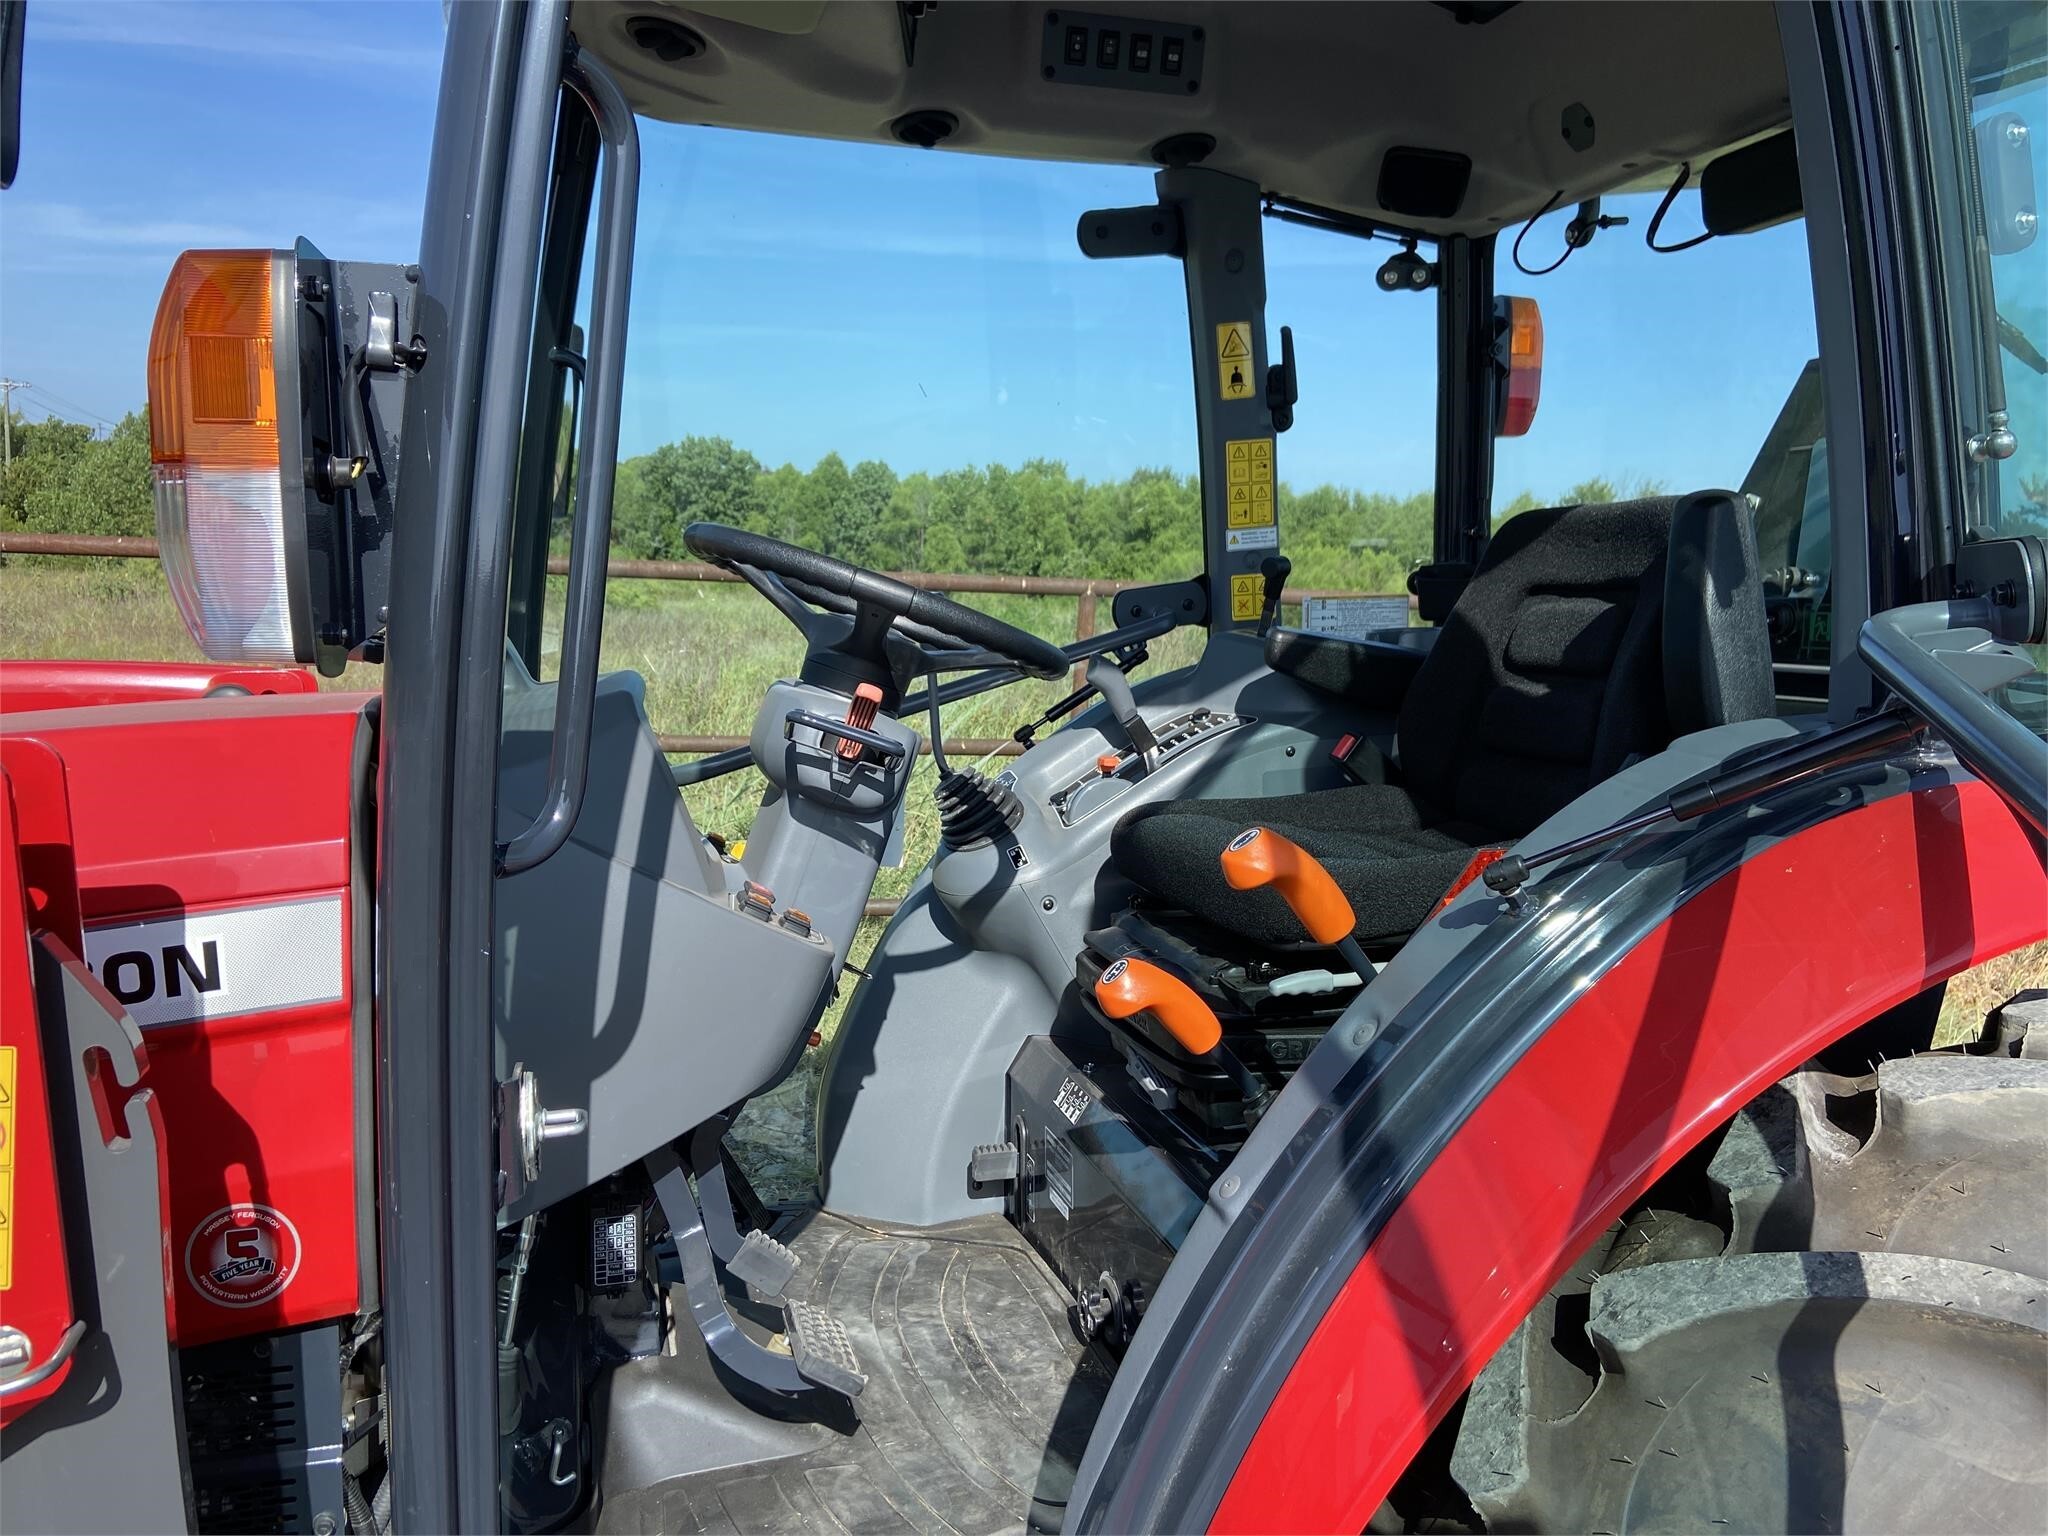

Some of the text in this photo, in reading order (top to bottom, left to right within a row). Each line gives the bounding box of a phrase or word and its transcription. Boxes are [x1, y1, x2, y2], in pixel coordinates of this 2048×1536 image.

[88, 940, 221, 1006] ON
[203, 1211, 281, 1237] MASSEY FERGUSON
[225, 1227, 260, 1276] 5
[200, 1266, 289, 1300] POWERTRAIN WARRANTY
[221, 1260, 260, 1280] FIVE YEAR
